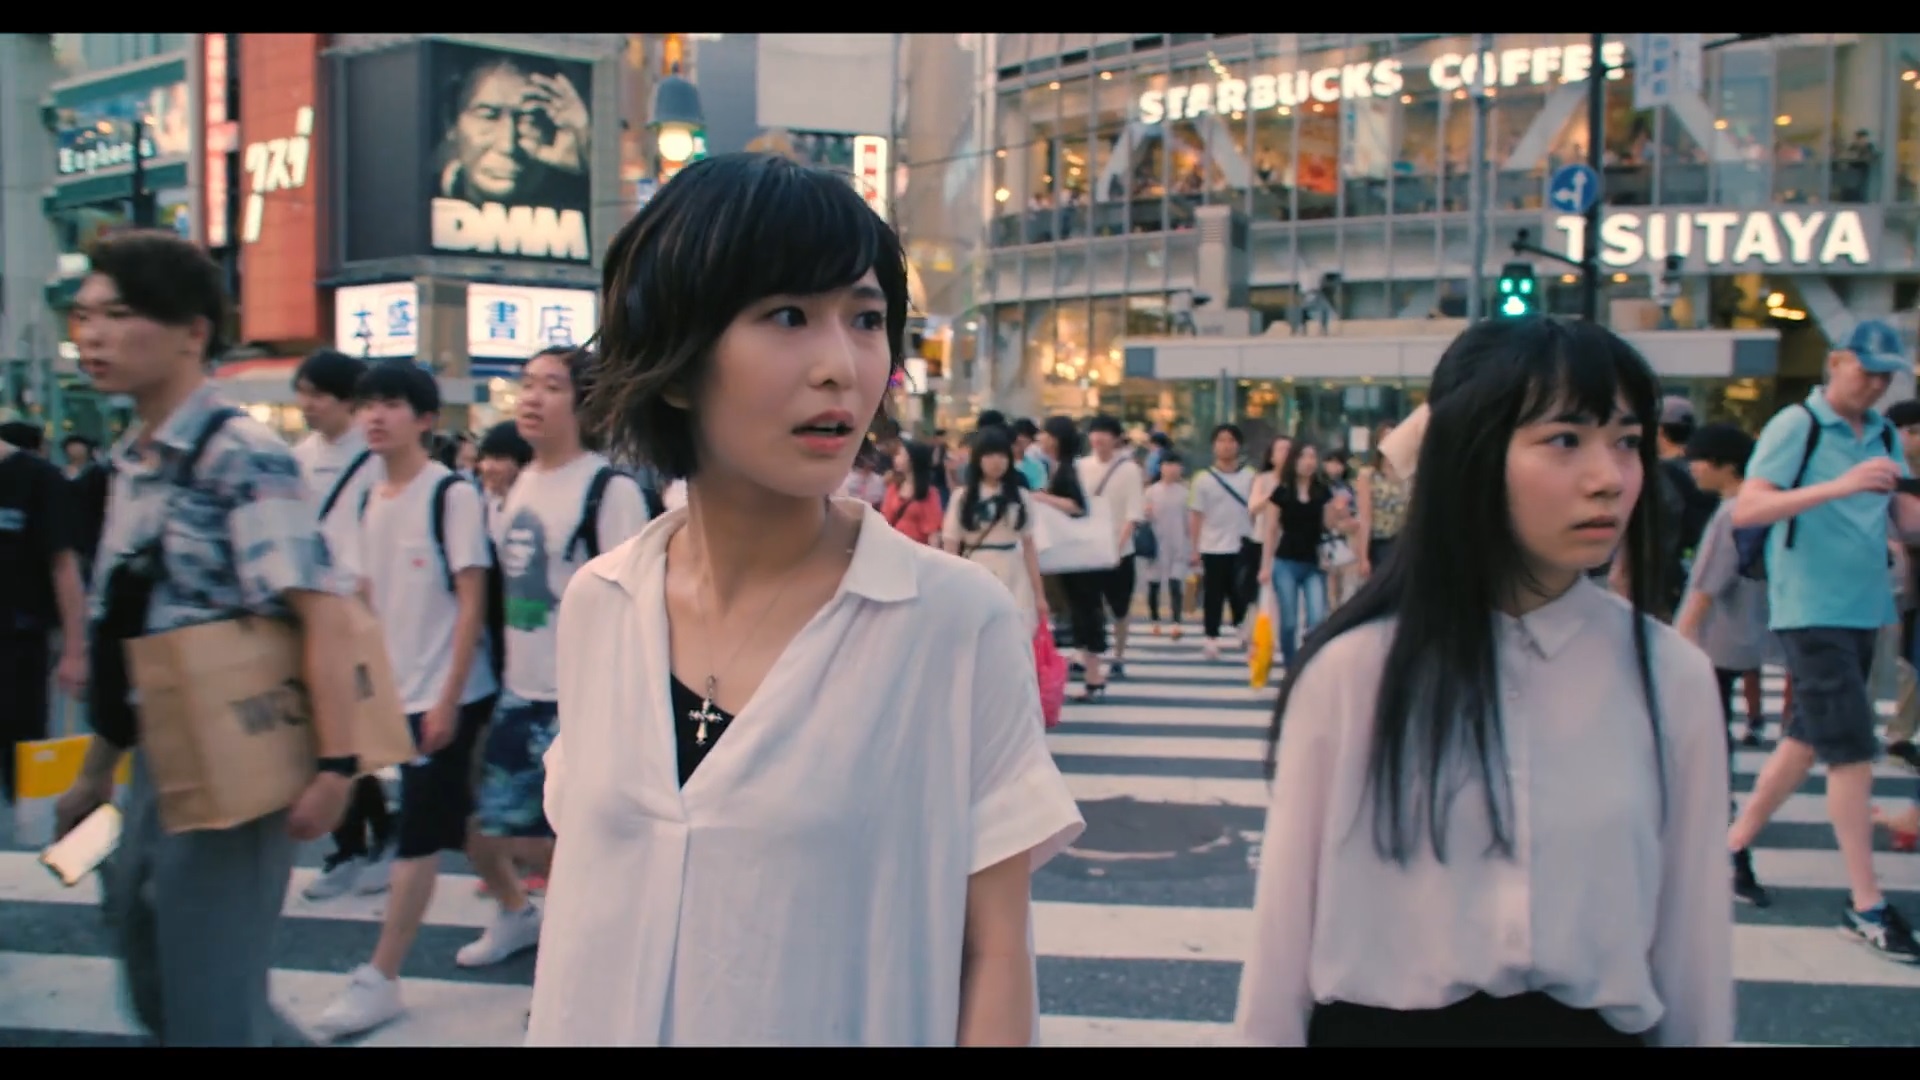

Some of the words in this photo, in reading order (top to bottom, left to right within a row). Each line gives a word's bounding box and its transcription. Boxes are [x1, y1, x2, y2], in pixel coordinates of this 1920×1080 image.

[1139, 58, 1404, 125] STARBUCKS
[1429, 41, 1625, 90] COFFEE
[59, 139, 154, 174] Euphora
[431, 196, 589, 260] DMM
[1556, 210, 1870, 267] TSUTAYA
